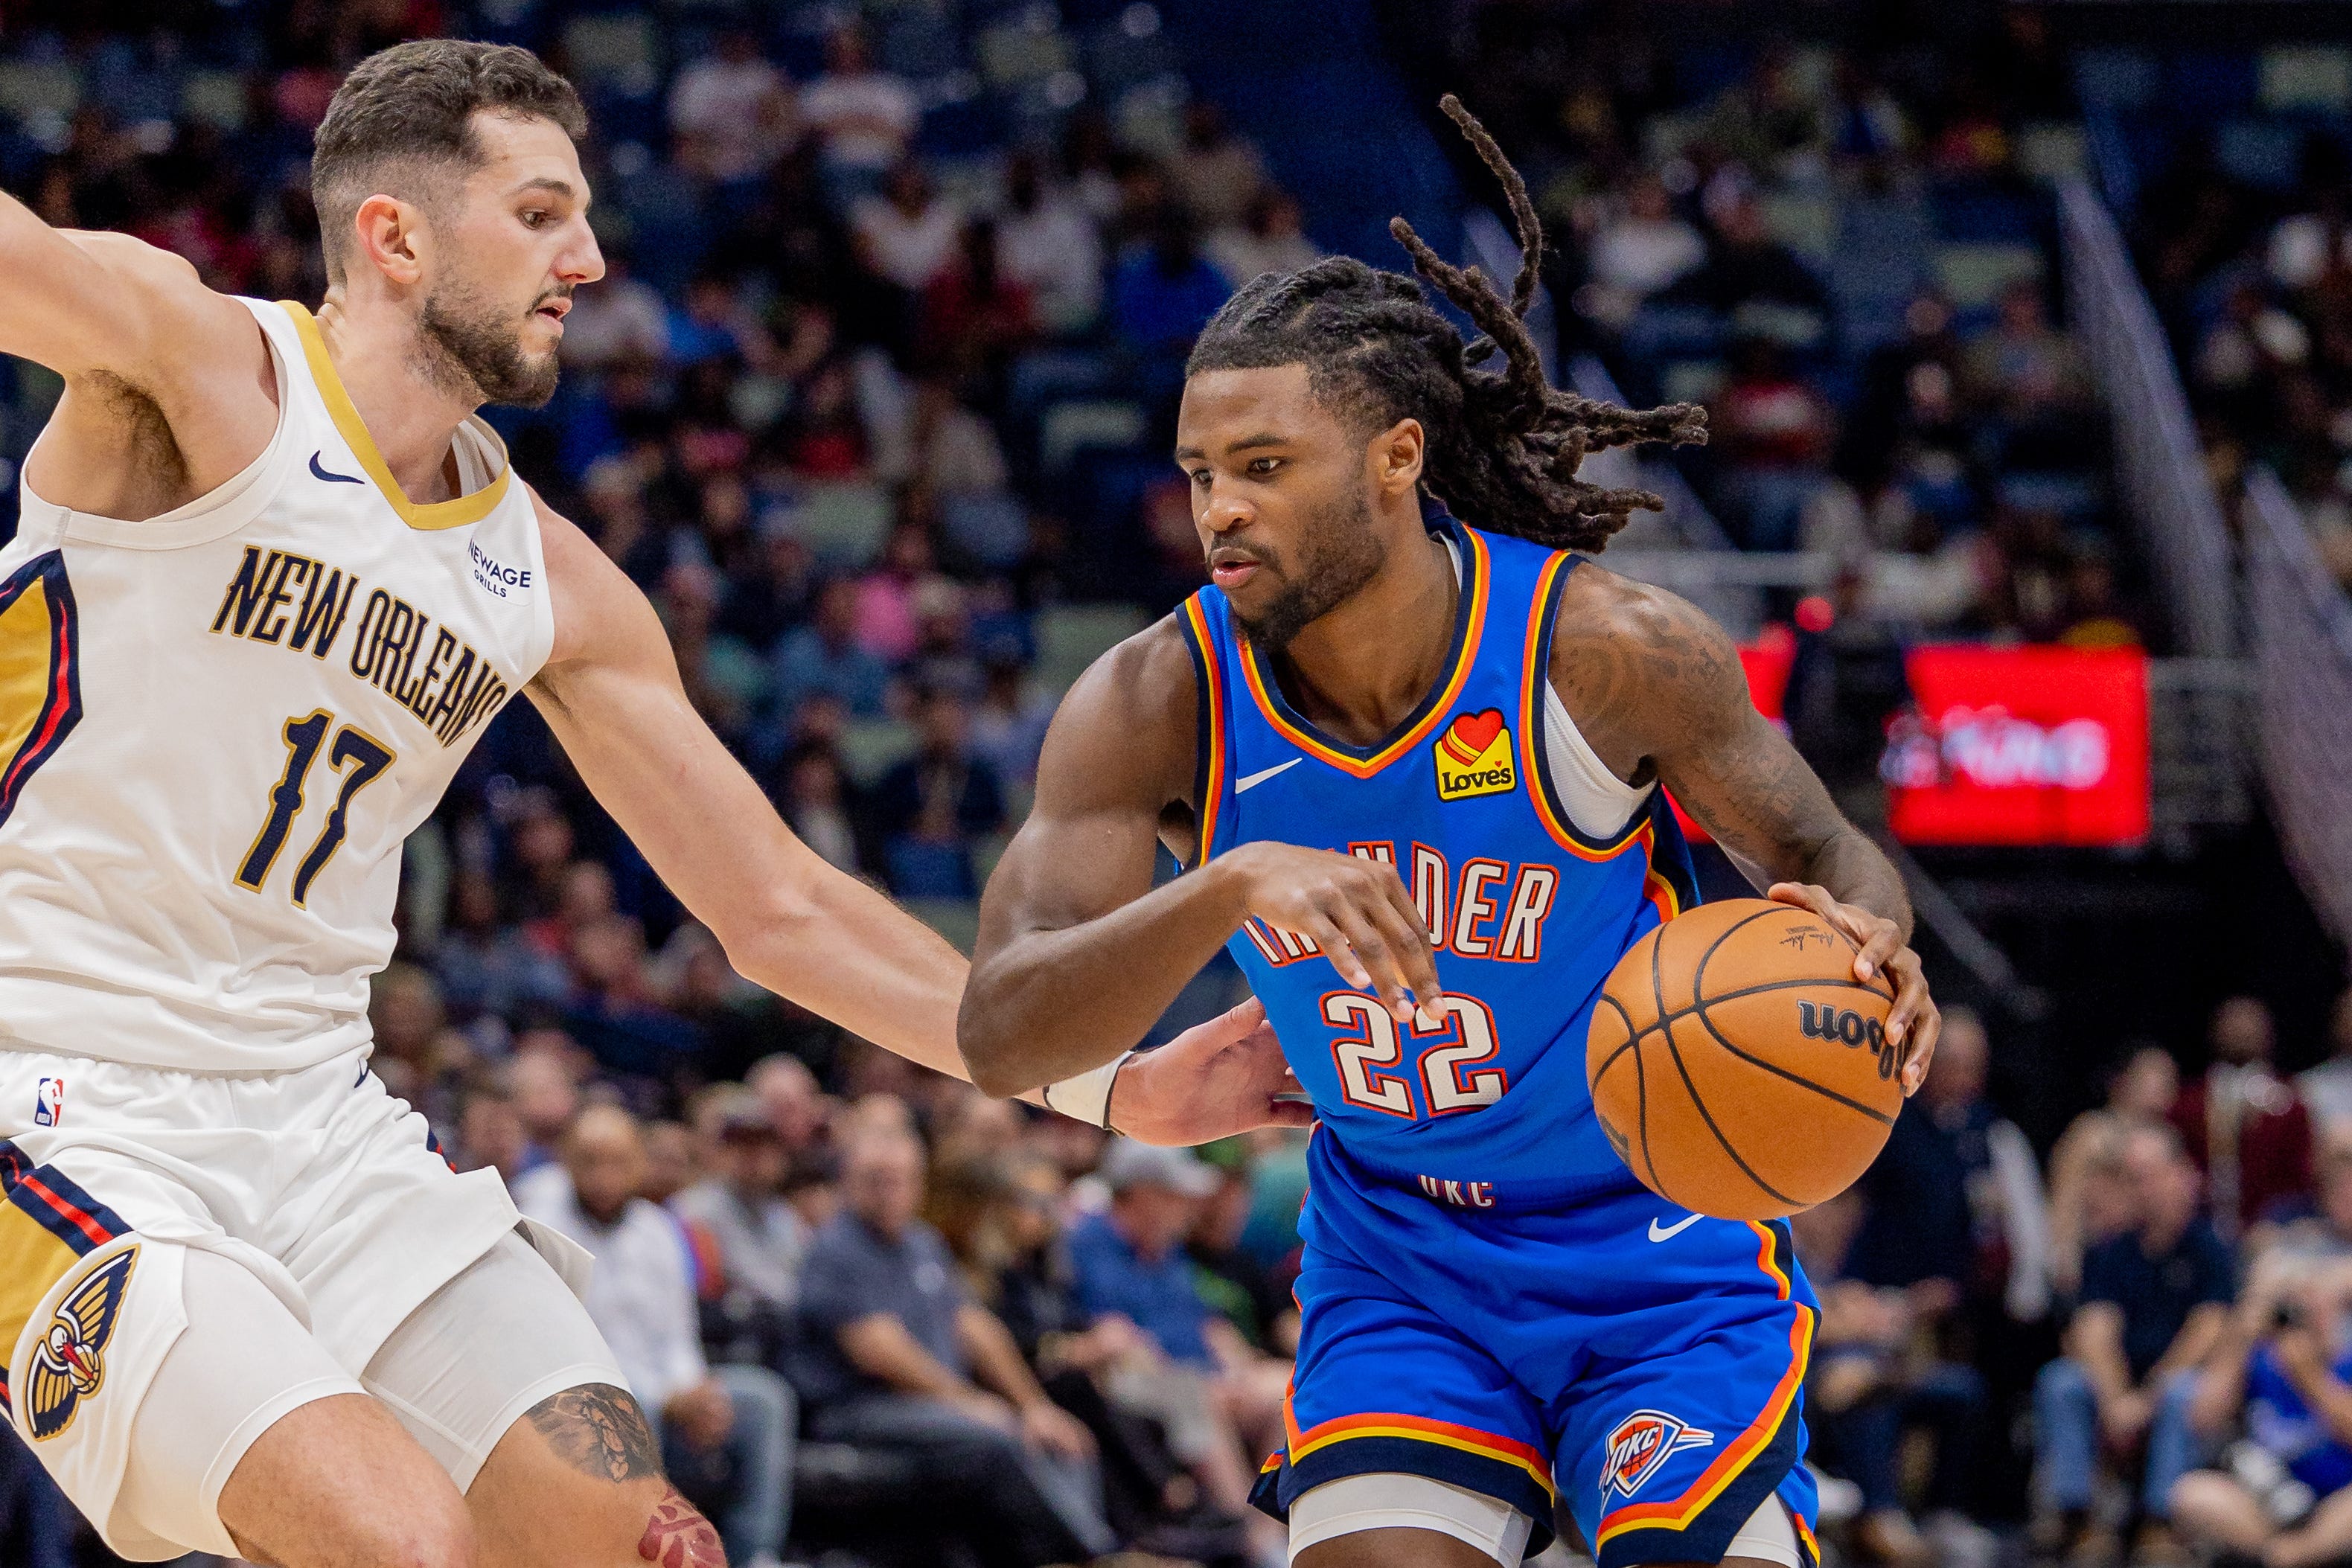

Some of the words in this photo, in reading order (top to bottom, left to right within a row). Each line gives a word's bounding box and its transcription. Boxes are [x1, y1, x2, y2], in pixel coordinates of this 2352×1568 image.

[209, 545, 360, 660] NEW
[467, 538, 531, 587] NEWAGE
[474, 569, 507, 598] GRILLS
[232, 708, 396, 910] 17
[1320, 989, 1509, 1120] 22
